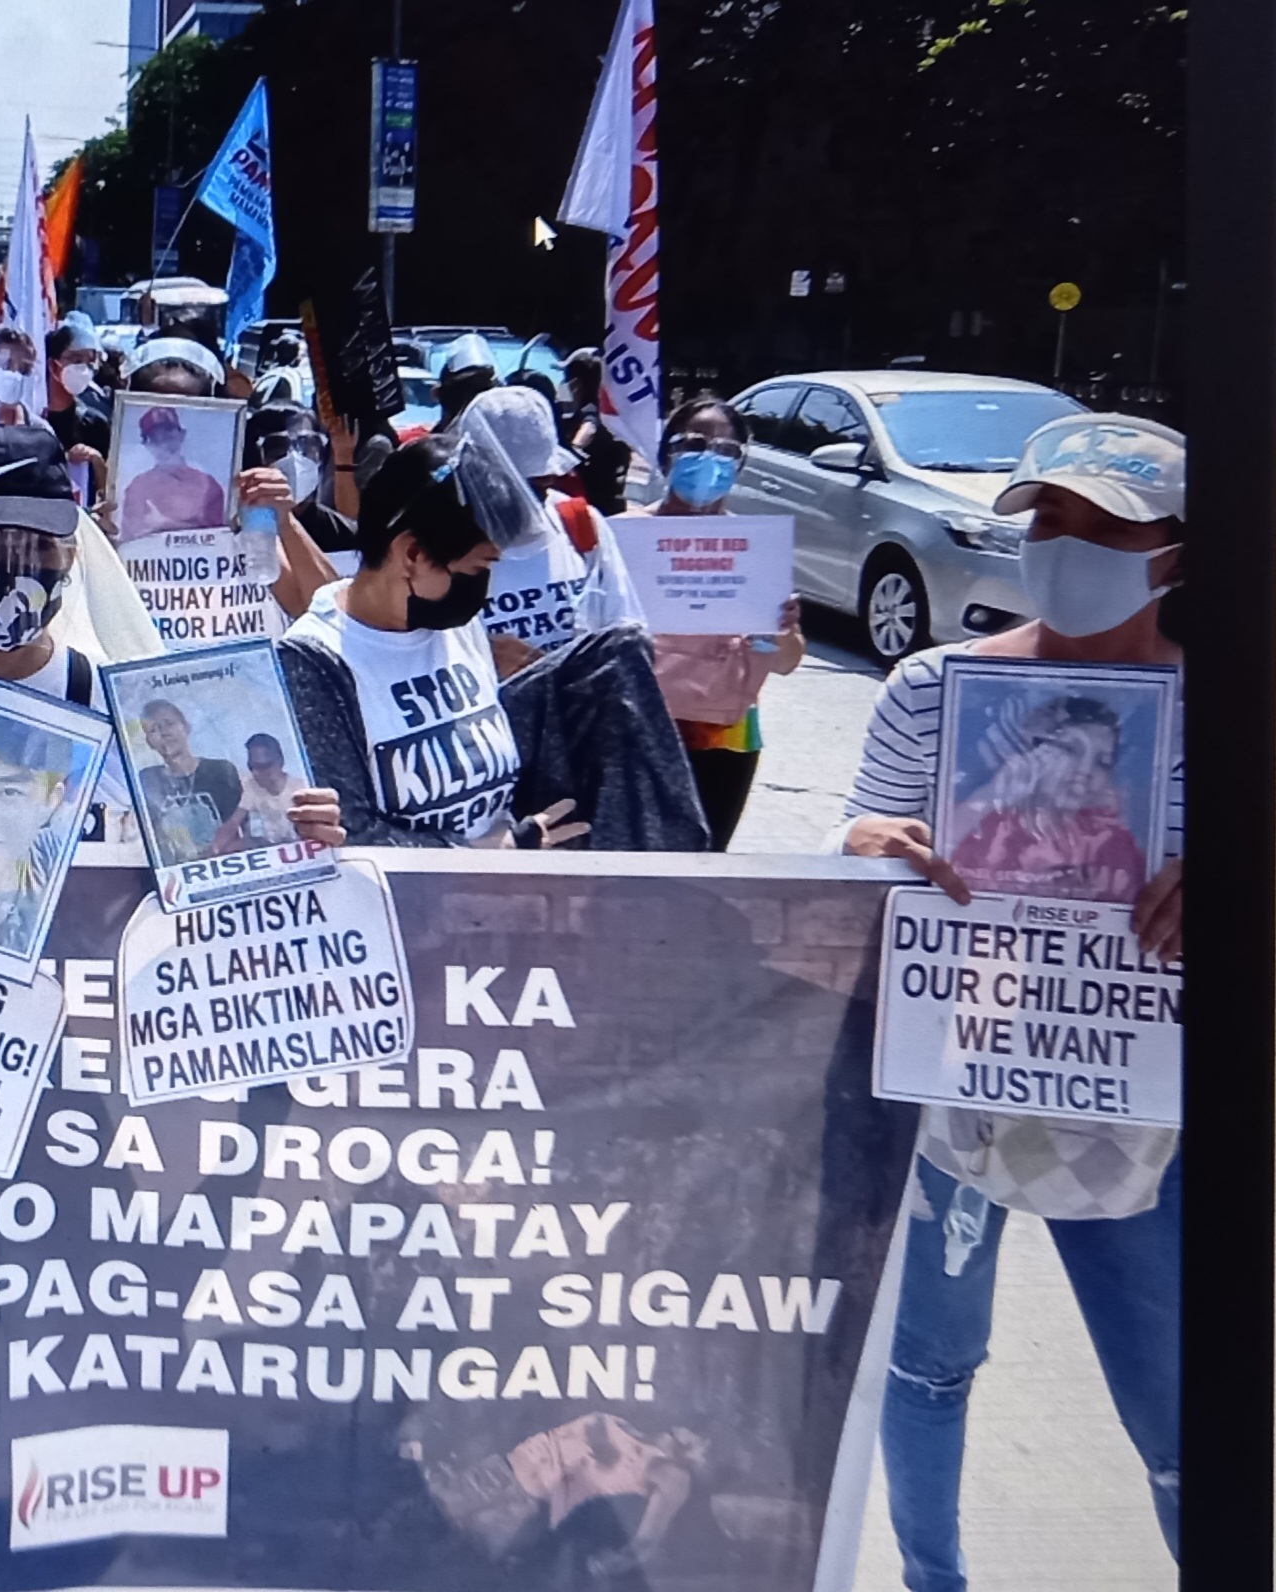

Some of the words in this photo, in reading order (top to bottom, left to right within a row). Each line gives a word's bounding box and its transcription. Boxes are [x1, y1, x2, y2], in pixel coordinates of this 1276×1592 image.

[656, 538, 691, 552] STOP
[695, 538, 719, 552] THE
[152, 617, 205, 640] ROR
[212, 609, 266, 637] LAW!
[390, 663, 481, 729] STOP
[182, 851, 271, 884] RISE
[278, 840, 328, 864] UP
[175, 889, 327, 948] HUSTISYA
[893, 914, 1068, 967] DUTERTE
[1026, 905, 1069, 922] RISE
[1072, 910, 1100, 924] UP
[155, 957, 199, 996] SA
[205, 937, 309, 988] LAHAT
[318, 929, 367, 970] NG
[129, 1002, 204, 1048] MGA
[210, 980, 345, 1034] BIKTIMA
[350, 970, 400, 1011] NG
[444, 965, 576, 1028] KA
[902, 963, 980, 1005] OUR
[992, 972, 1184, 1025] CHILDREN
[143, 1016, 406, 1092] PAMAMASLANG!
[955, 1013, 1014, 1056] WE
[1025, 1021, 1137, 1068] WANT
[957, 1062, 1131, 1115] JUSTICE!
[45, 1109, 165, 1173] SA
[199, 1120, 556, 1186] DROGA!
[90, 1187, 632, 1260] MAPAPATAY
[395, 1276, 511, 1332] AT
[538, 1271, 844, 1335] SIGAW
[8, 1333, 656, 1402] KATARUNGAN!
[47, 1463, 147, 1509] RISE
[158, 1465, 221, 1500] UP
